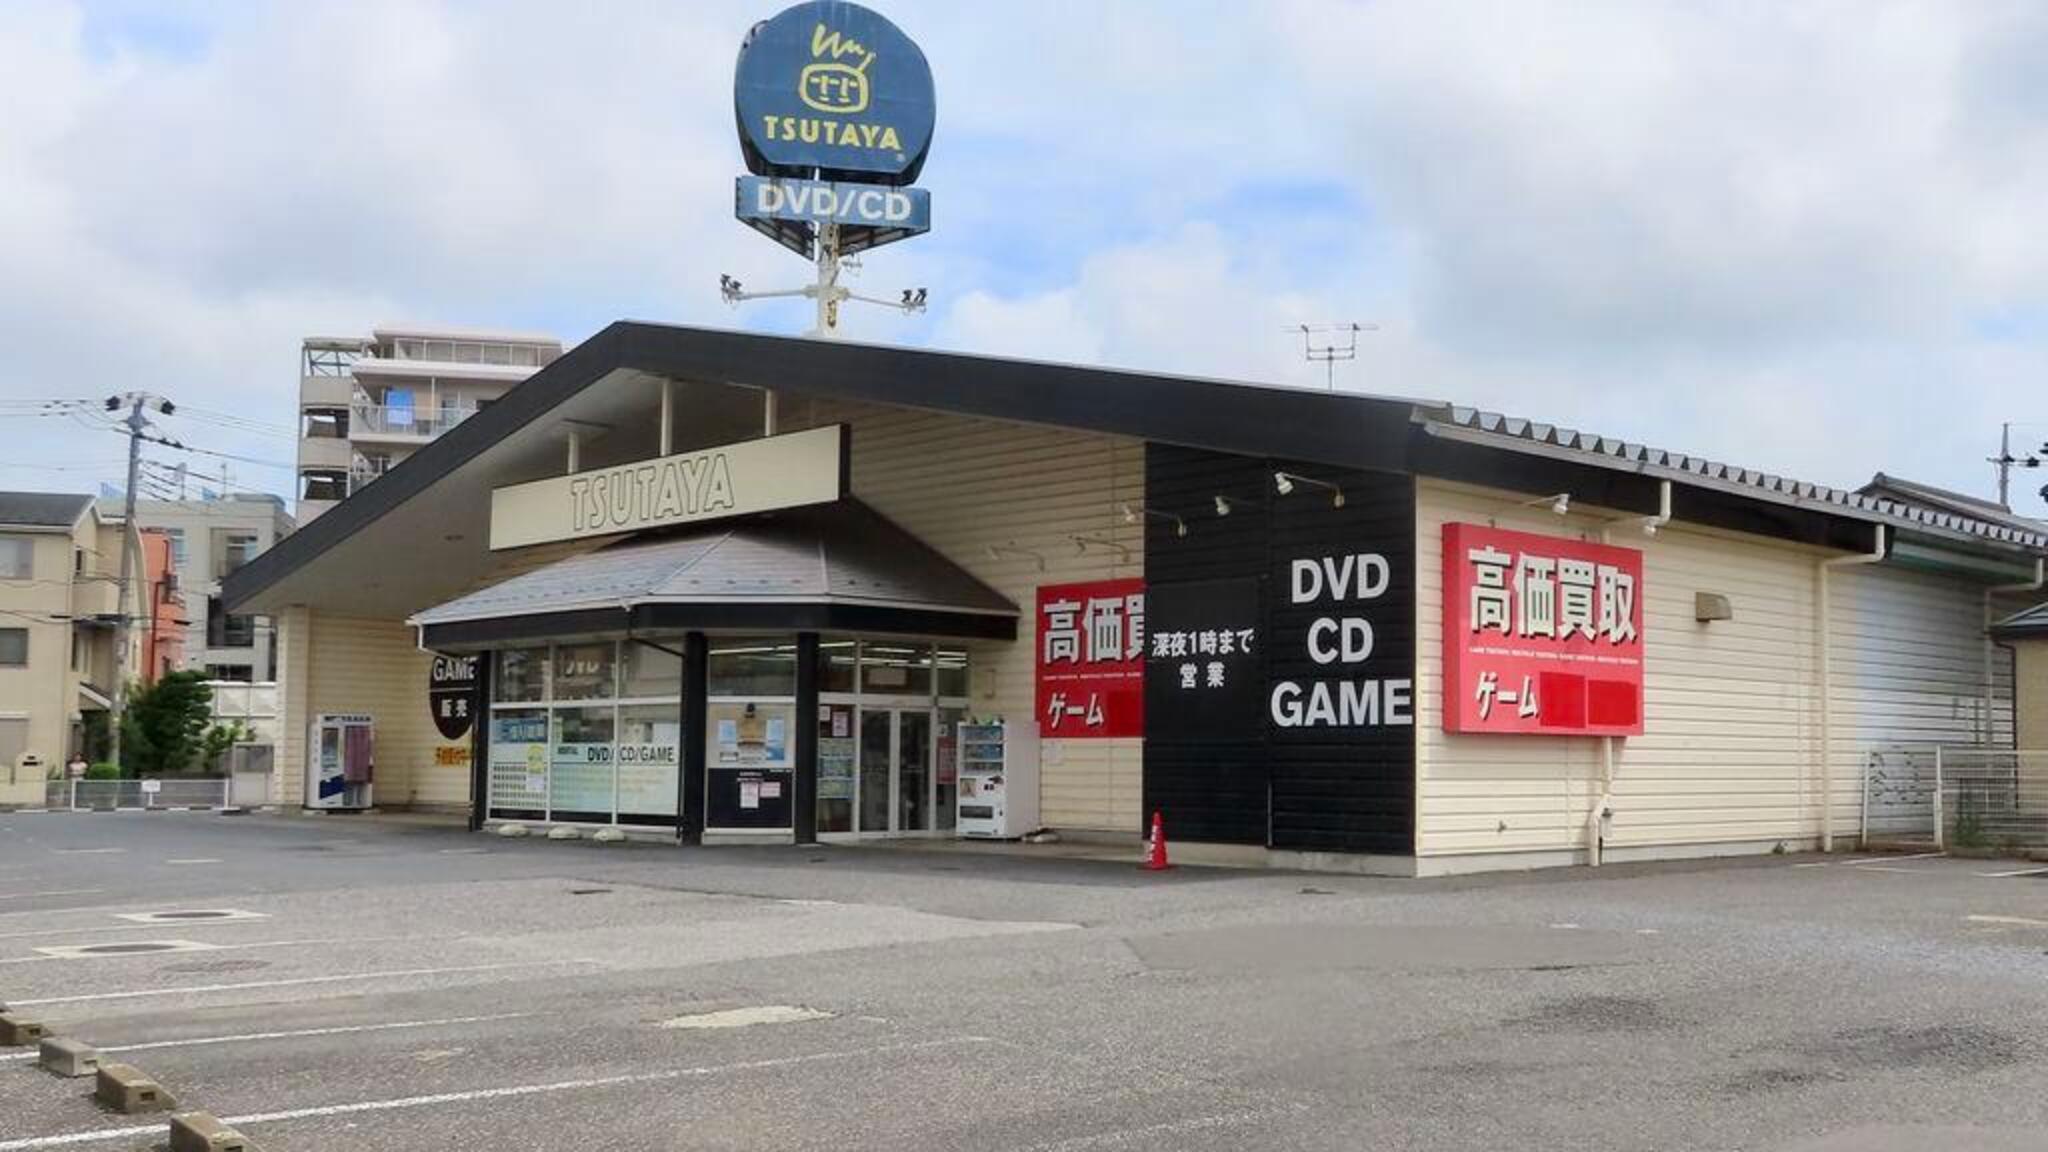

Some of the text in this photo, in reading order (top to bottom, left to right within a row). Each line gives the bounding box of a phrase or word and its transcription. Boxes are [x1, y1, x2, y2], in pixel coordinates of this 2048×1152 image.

[764, 115, 902, 151] TSUTAYA
[758, 183, 912, 220] DVD/CD
[571, 453, 735, 531] TSUTAYA
[1291, 554, 1390, 603] DVD
[1468, 545, 1637, 643] 高価買取
[1151, 628, 1255, 658] 深夜1時まで
[1307, 617, 1374, 665] CD
[433, 657, 478, 681] GAME
[1179, 662, 1226, 689] 営業
[1048, 693, 1104, 728] ゲーム
[1271, 679, 1414, 727] GAME
[1476, 671, 1540, 719] ゲーム
